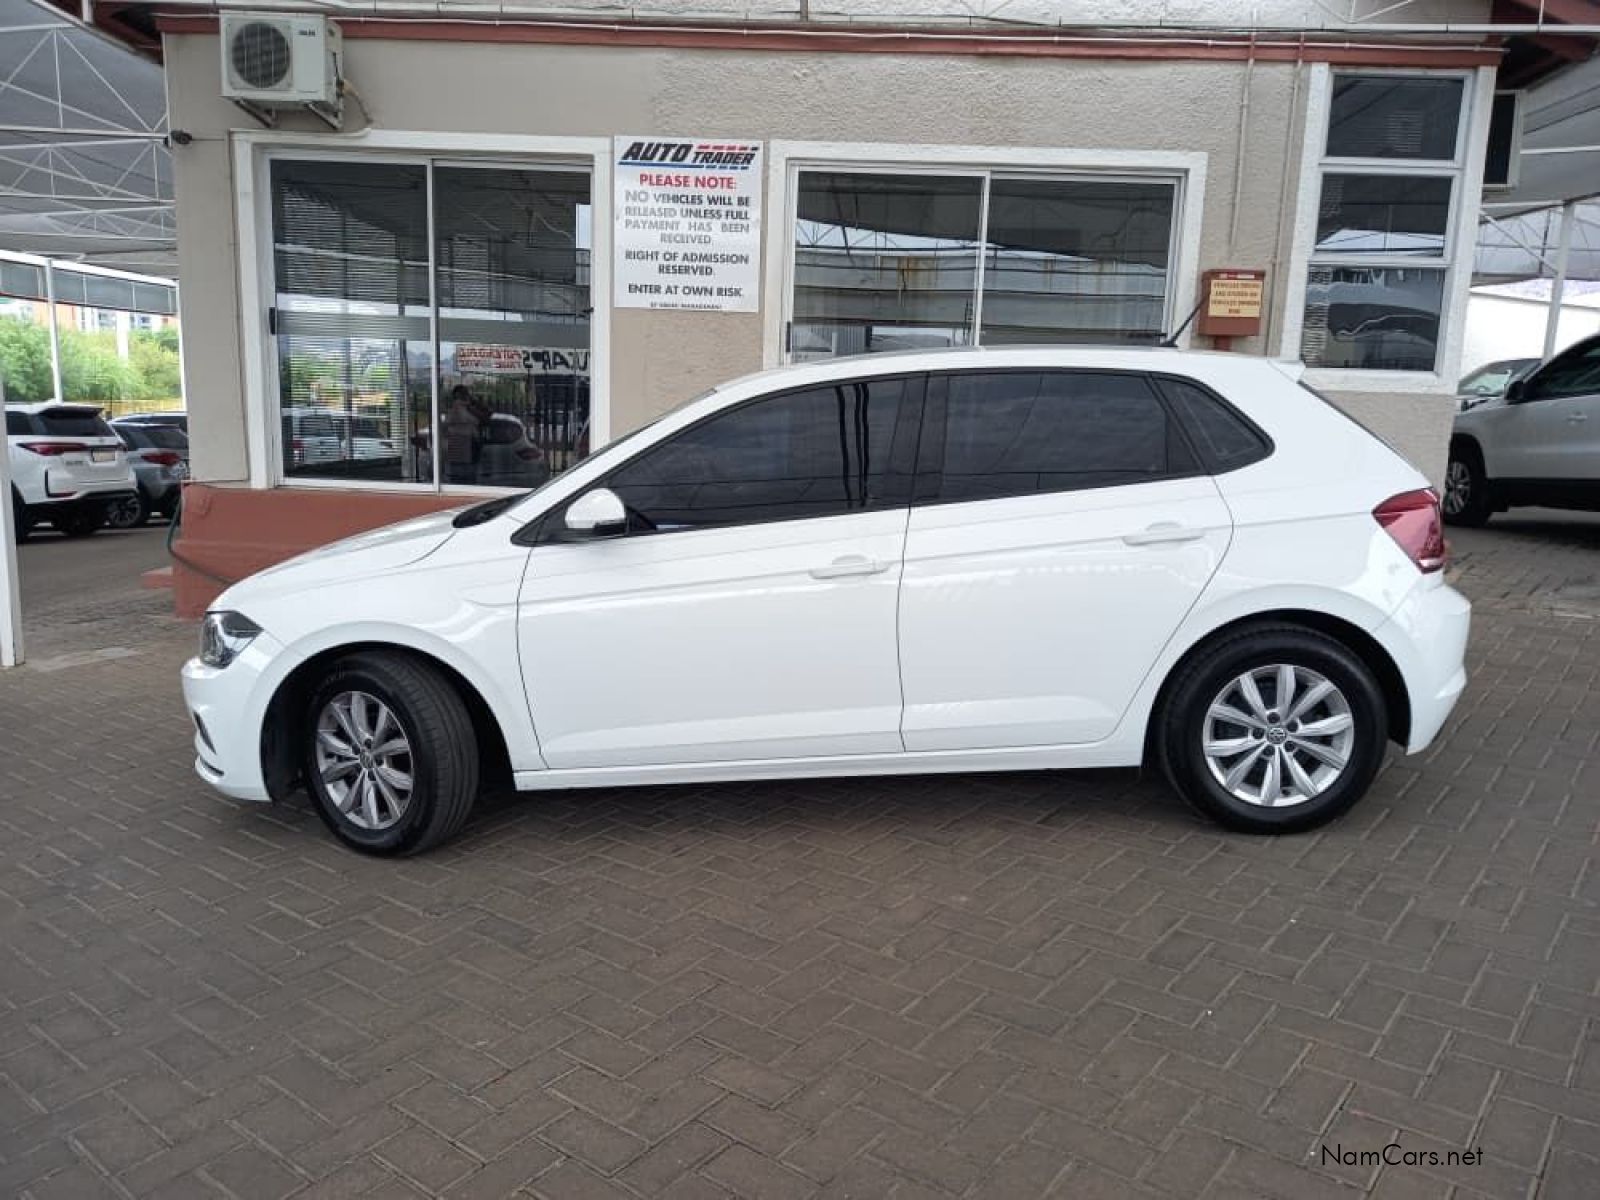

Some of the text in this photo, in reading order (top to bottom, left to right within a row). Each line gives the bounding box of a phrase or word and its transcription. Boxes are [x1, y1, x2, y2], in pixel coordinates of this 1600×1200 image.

[621, 142, 756, 164] AUTO TRADER
[640, 174, 690, 187] PLEASE
[625, 190, 750, 206] NO VEHICLES WILL BE
[625, 207, 750, 220] RELEASED UNLESS FULL
[625, 219, 750, 233] PAYMENT HAS BEEN
[625, 250, 749, 264] RIGHT OF ADMISSION
[628, 284, 662, 295] ENTER
[665, 285, 679, 295] AT
[682, 286, 713, 296] OWN
